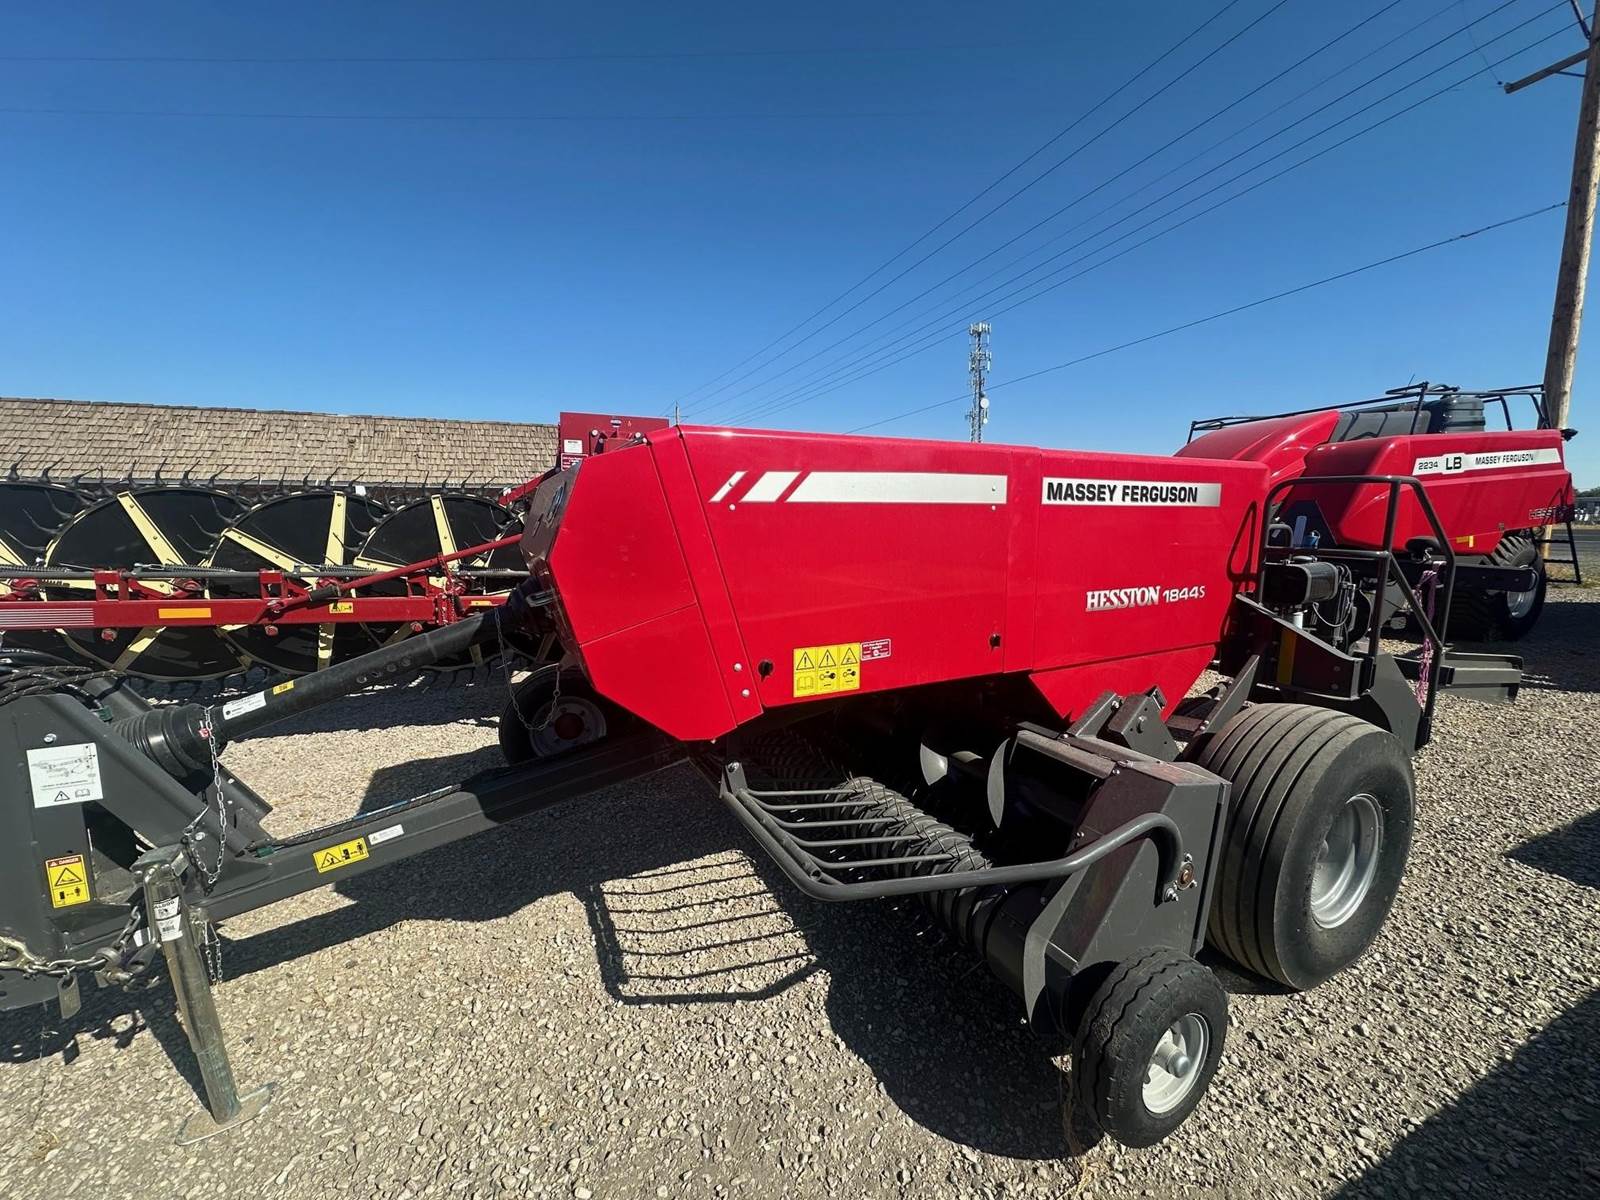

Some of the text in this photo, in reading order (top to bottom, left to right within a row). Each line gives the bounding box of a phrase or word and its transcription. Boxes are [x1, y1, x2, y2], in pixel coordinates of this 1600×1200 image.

[1418, 453, 1534, 471] 2234 LB MASSEY FERGUSON
[1046, 482, 1198, 503] MASSEY FERGUSON
[1086, 586, 1206, 611] HESSTON 1844S
